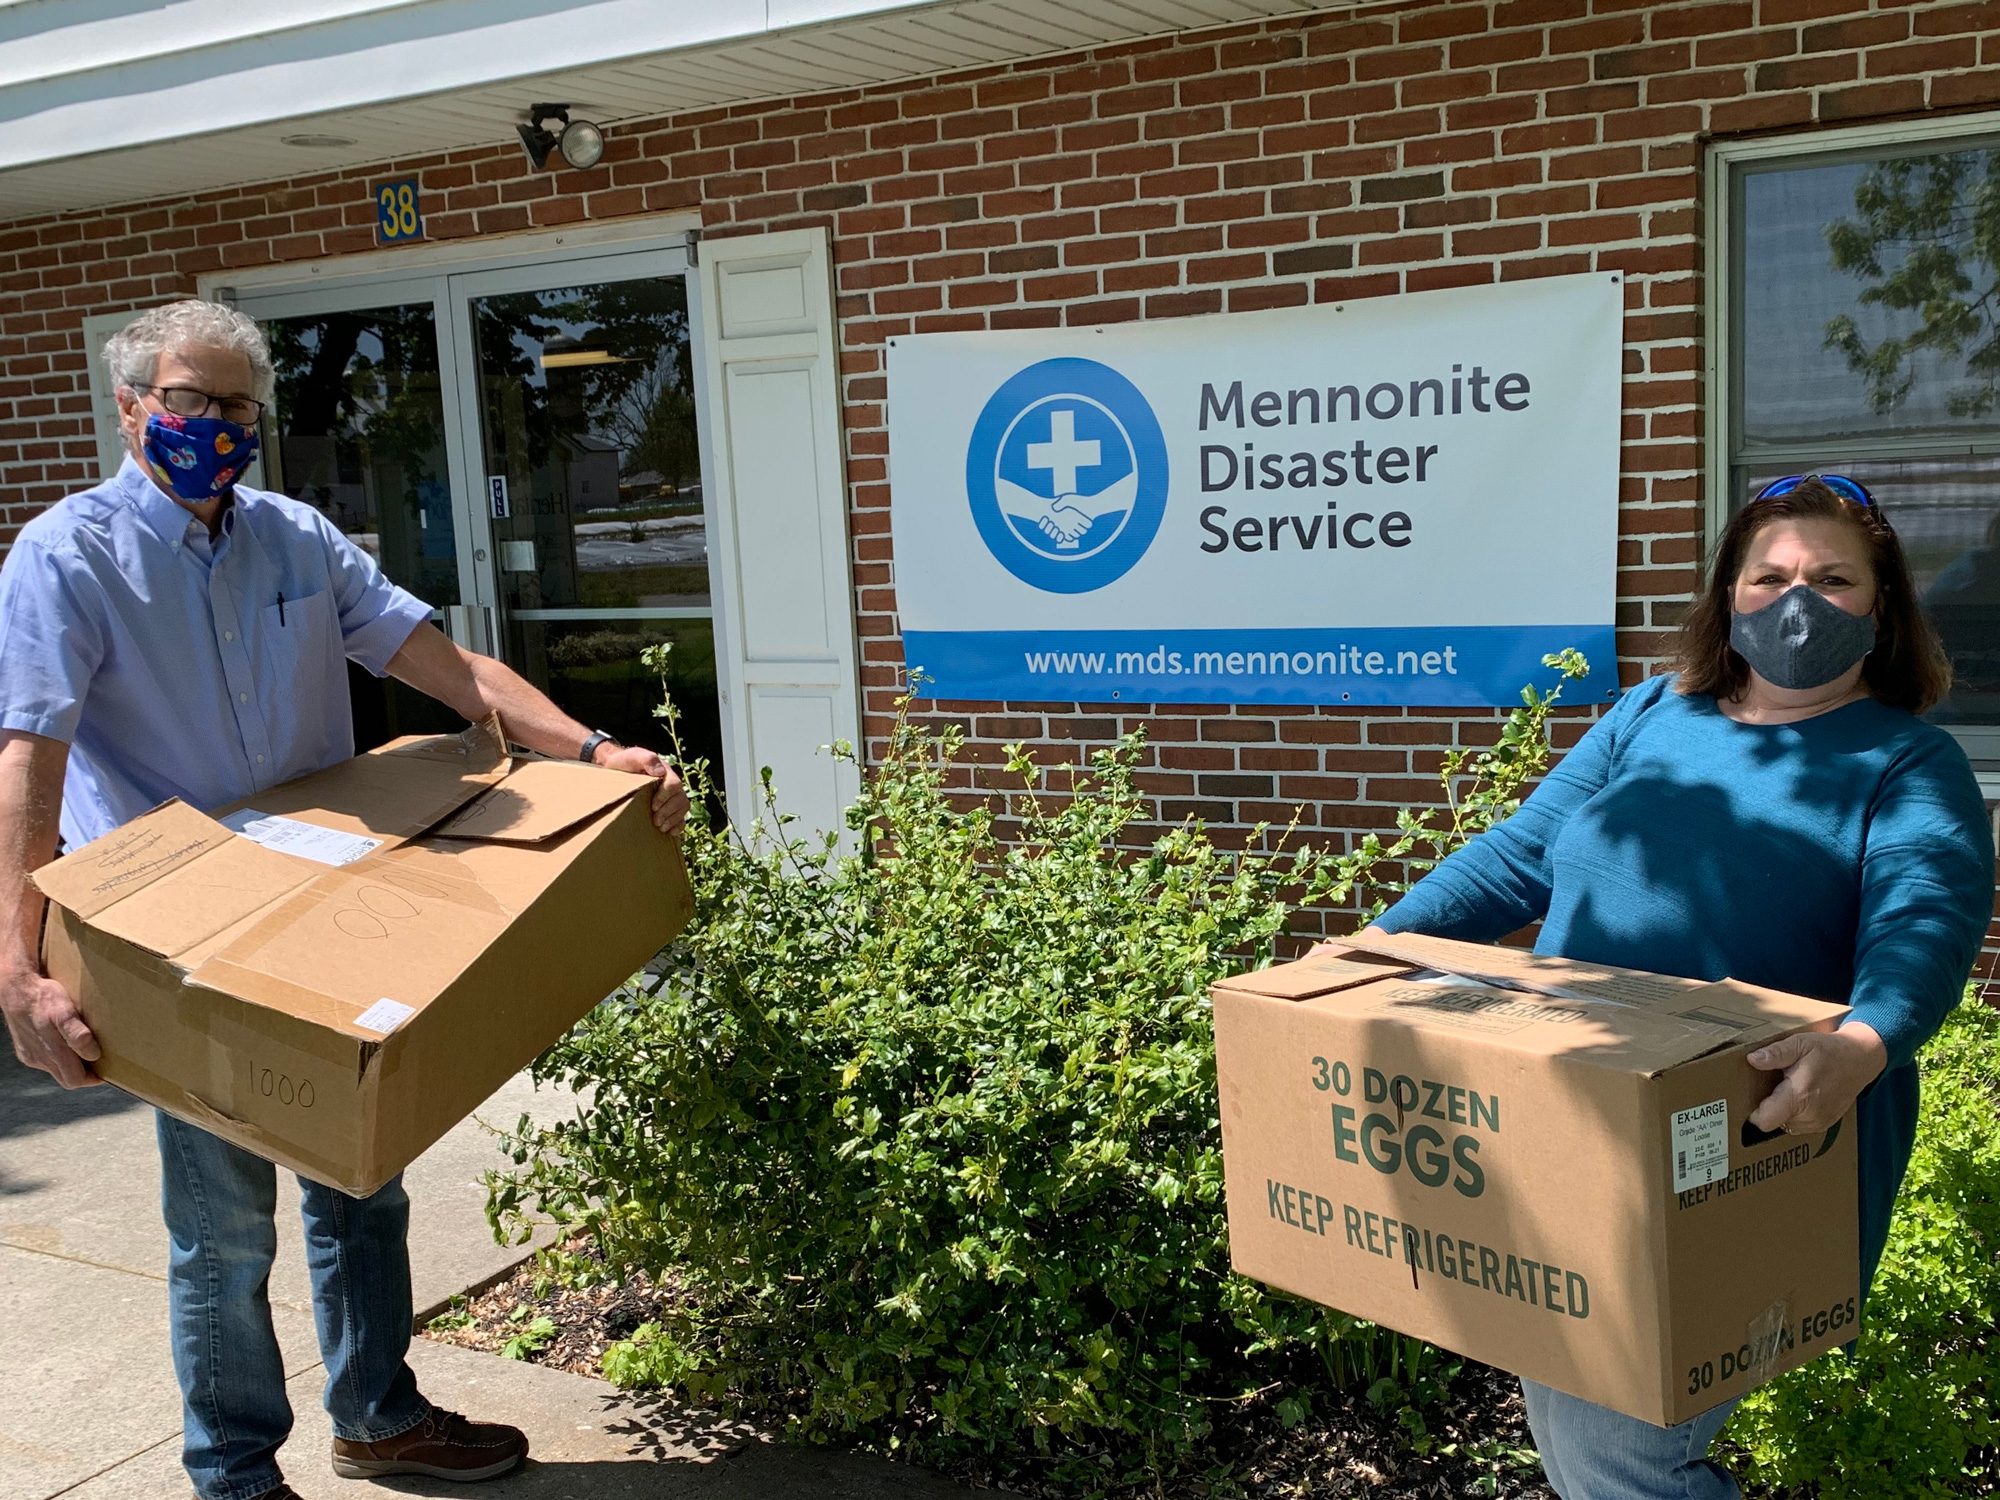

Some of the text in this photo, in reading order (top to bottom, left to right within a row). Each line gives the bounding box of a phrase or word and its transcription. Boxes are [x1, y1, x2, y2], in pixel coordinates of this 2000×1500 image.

[381, 184, 417, 237] 38
[1199, 364, 1531, 431] Mennonite
[1200, 440, 1438, 492] Disaster
[494, 481, 503, 515] PULL
[1200, 501, 1412, 553] Service
[1025, 644, 1457, 675] www.mds.mennonite.net
[1380, 987, 1438, 1001] KEEP
[1436, 991, 1590, 1024] REFRIGERATED
[250, 1060, 315, 1108] 1000
[1311, 1056, 1500, 1133] 30 DOZEN
[1677, 1101, 1725, 1125] EX-LARGE
[1679, 1127, 1696, 1137] Grade
[1694, 1132, 1711, 1142] Loose
[1331, 1103, 1485, 1198] EGGS
[1679, 1182, 1713, 1211] KEEP
[1717, 1143, 1810, 1197] REFRIGERATED
[1266, 1178, 1591, 1319] KEEP REFRIGERATED
[1688, 1361, 1714, 1396] 30
[1801, 1297, 1855, 1344] EGGS
